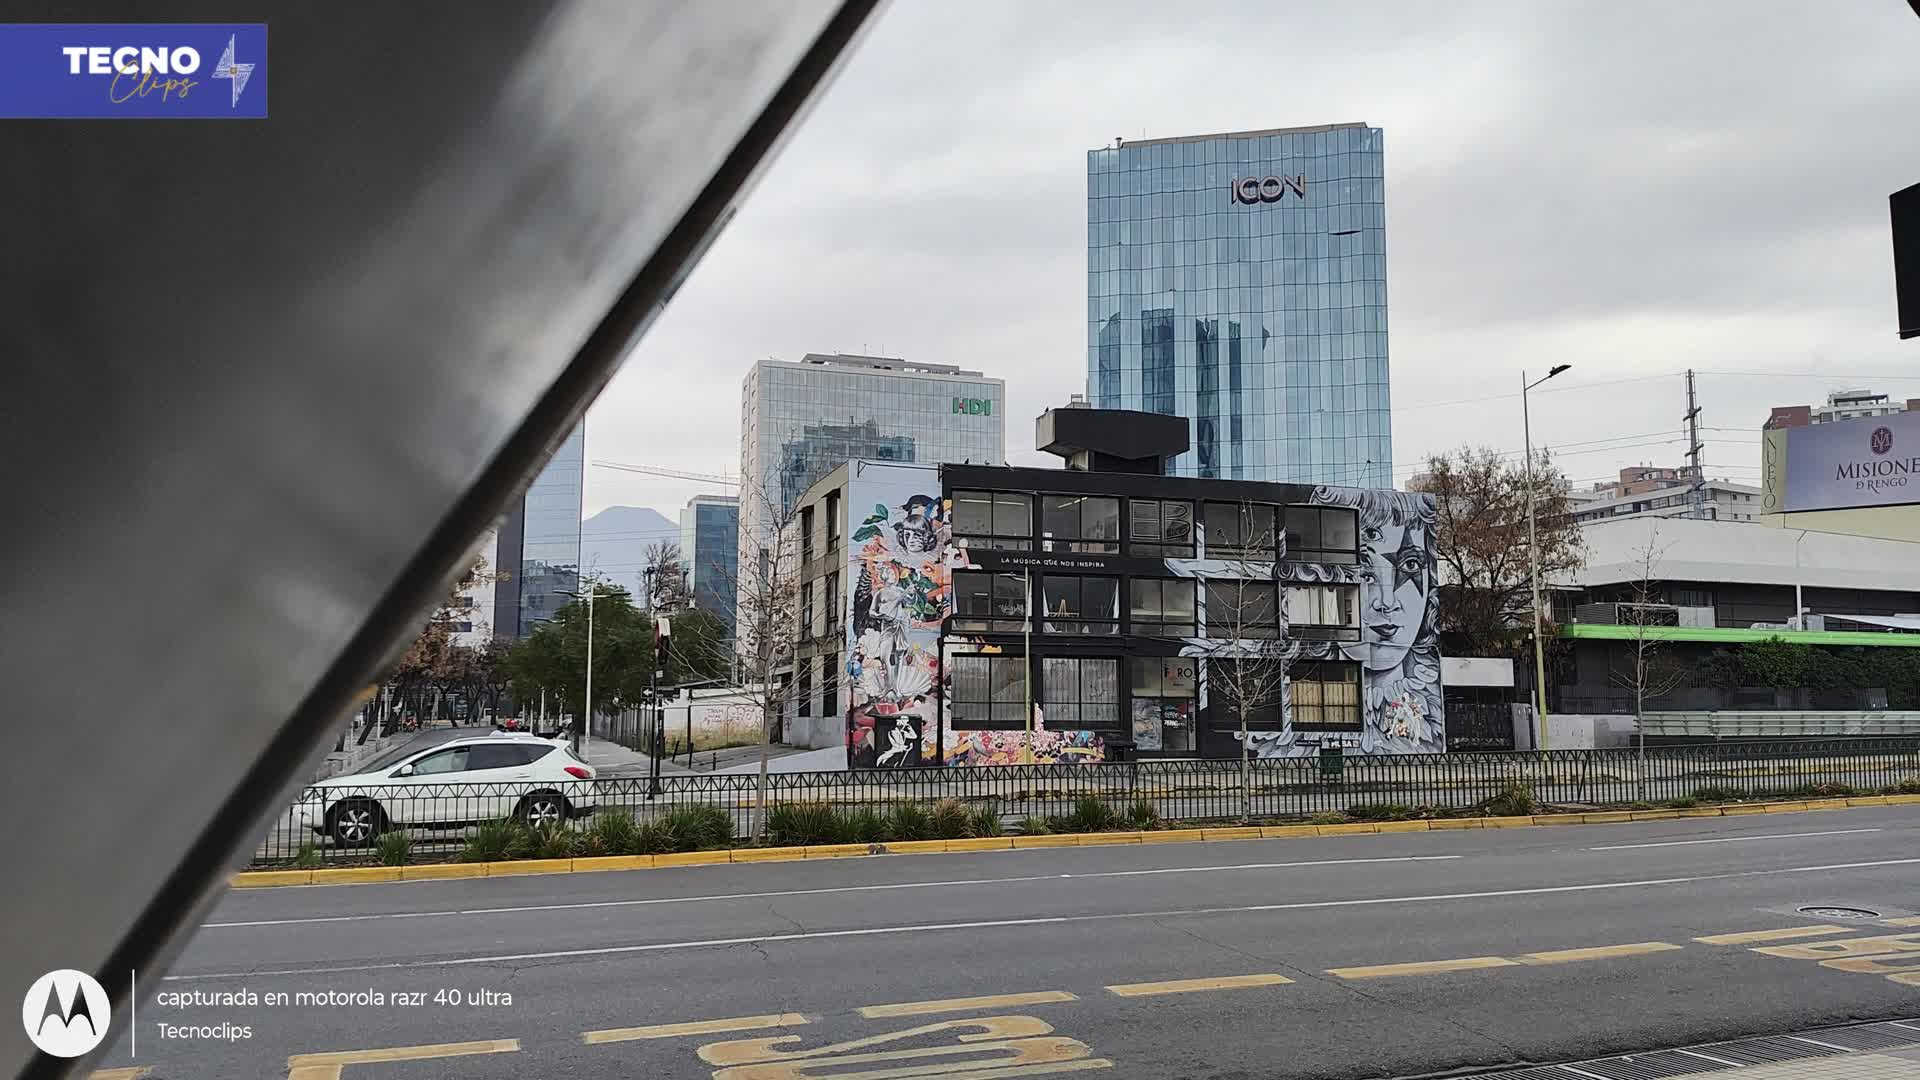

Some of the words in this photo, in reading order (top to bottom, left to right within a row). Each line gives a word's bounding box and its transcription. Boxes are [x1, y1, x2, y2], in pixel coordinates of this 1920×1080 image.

[1231, 173, 1305, 205] ICON
[952, 397, 992, 416] HDI
[1867, 477, 1908, 494] RENGO
